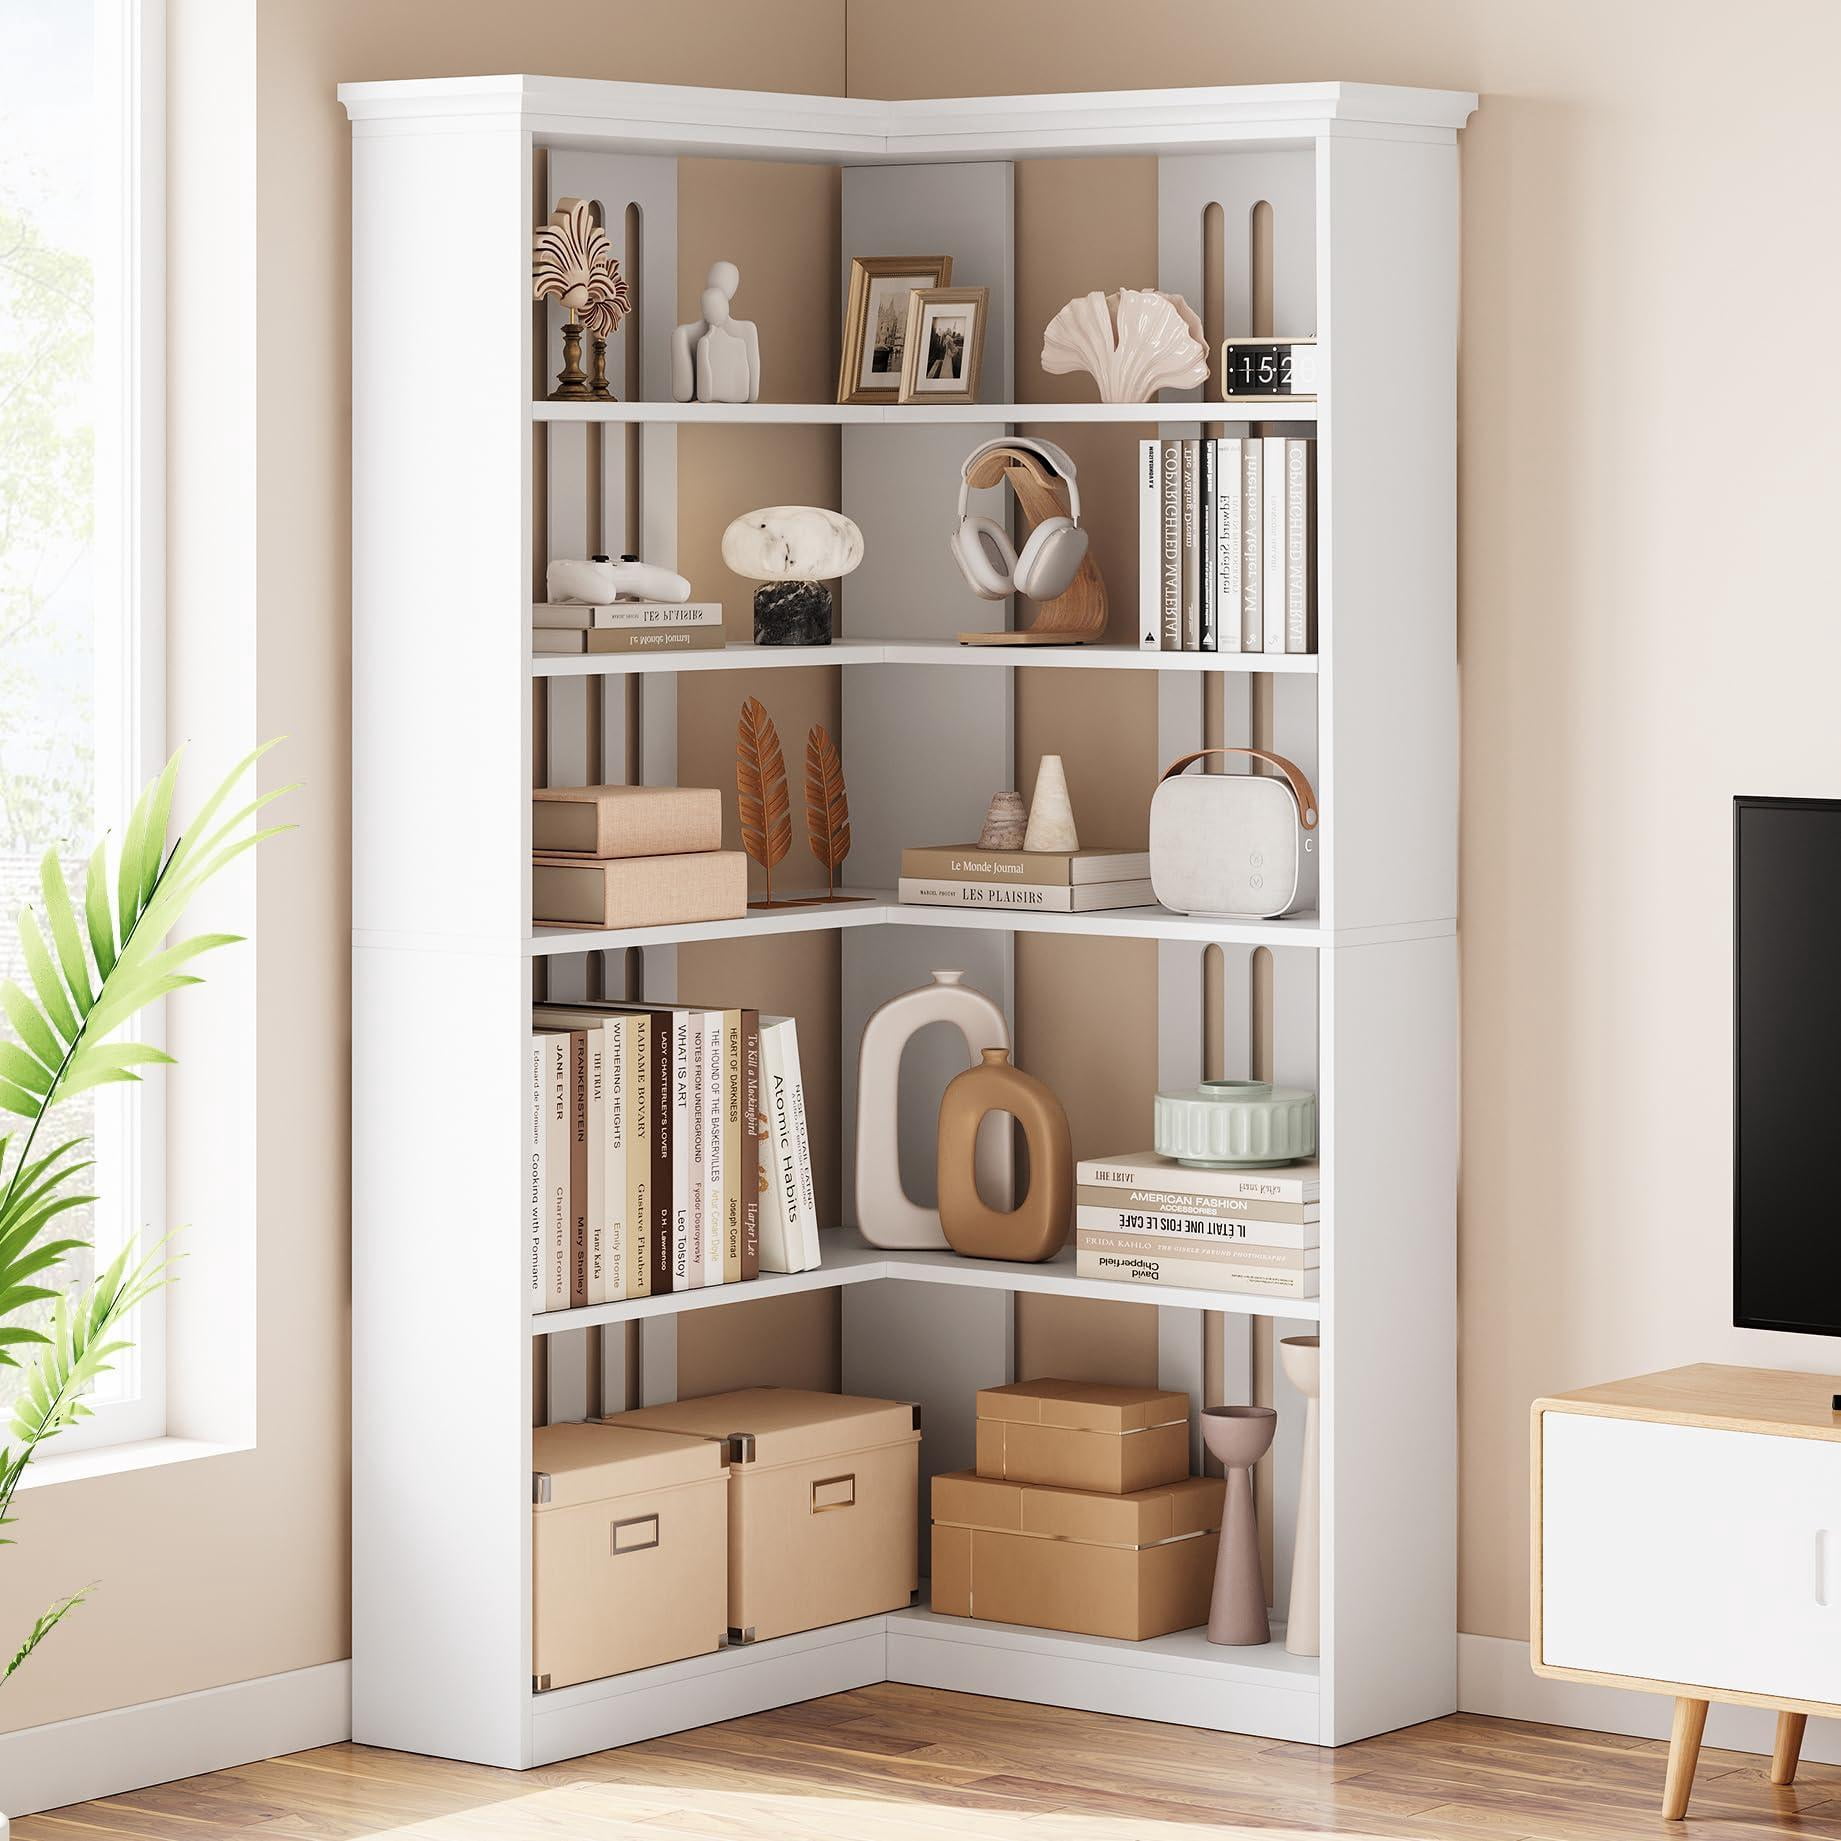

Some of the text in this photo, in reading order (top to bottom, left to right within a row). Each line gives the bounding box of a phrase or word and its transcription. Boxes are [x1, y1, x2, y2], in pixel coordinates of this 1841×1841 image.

[952, 861, 1024, 874] Le Monde Journal
[963, 888, 983, 901] LES
[989, 890, 1043, 904] PLAISIRS
[712, 1029, 720, 1046] THE
[748, 1034, 758, 1047] To
[712, 1050, 720, 1080] HOUND
[748, 1050, 758, 1067] Kill
[533, 1091, 540, 1102] de
[712, 1083, 720, 1094] OF
[712, 1098, 720, 1115] THE
[745, 1078, 758, 1136] Mockingbird
[675, 1025, 687, 1278] WHAT IS ART Leo Tolstoy
[712, 1118, 720, 1183] BASKERVILLES
[729, 1028, 738, 1258] HEART OF DARKNESS Joseph Conrad
[774, 1075, 798, 1224] Atomic Habits
[795, 1084, 803, 1117] NOSE
[800, 1120, 806, 1136] TO
[804, 1167, 814, 1210] EATING
[532, 1153, 540, 1203] Cooking
[694, 1183, 702, 1210] Fyodor
[1130, 1192, 1248, 1210] AMERICAN FASHION
[532, 1207, 540, 1233] with
[745, 1203, 758, 1237] Harper
[1160, 1204, 1217, 1215] ACCESSORIES
[612, 1223, 621, 1251] Emily
[1120, 1214, 1246, 1239] IL ÉTAIT UNE FOIS LE CAFÉ
[748, 1240, 758, 1256] Lee
[532, 1237, 540, 1290] Pomiane
[1099, 1258, 1159, 1271] Chipperfield
[1132, 1270, 1159, 1280] David
